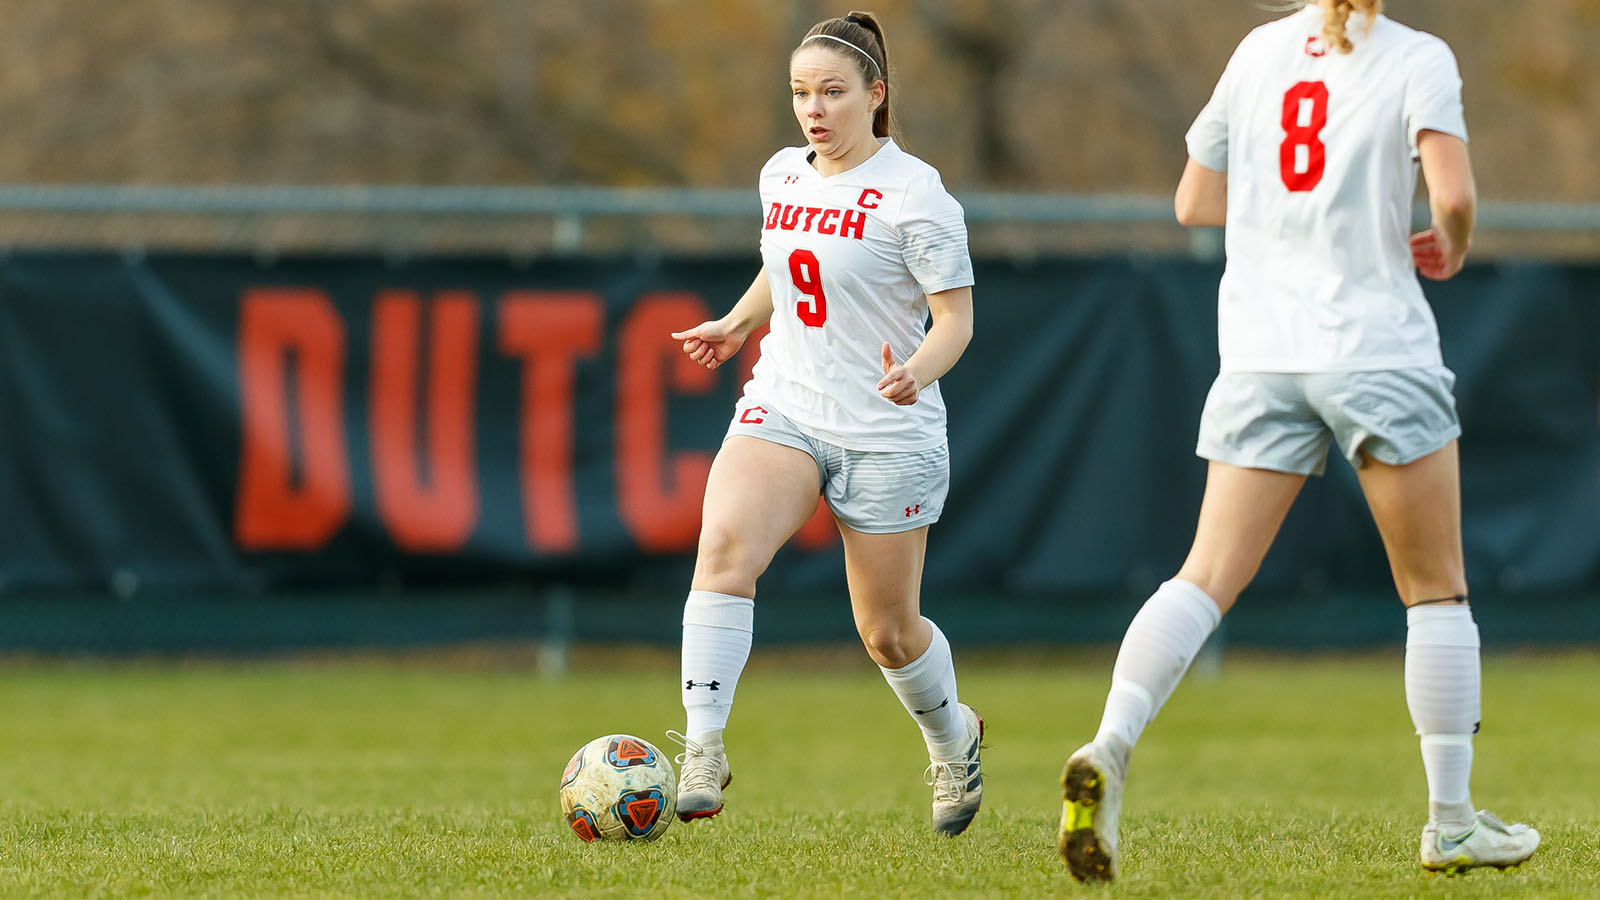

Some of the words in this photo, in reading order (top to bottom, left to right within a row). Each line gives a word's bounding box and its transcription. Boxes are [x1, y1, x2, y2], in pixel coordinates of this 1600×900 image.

[1279, 80, 1329, 192] 8
[765, 202, 867, 240] DUTCH
[857, 188, 883, 210] C
[788, 248, 828, 329] 9
[234, 287, 838, 554] DUTC
[739, 405, 768, 424] C
